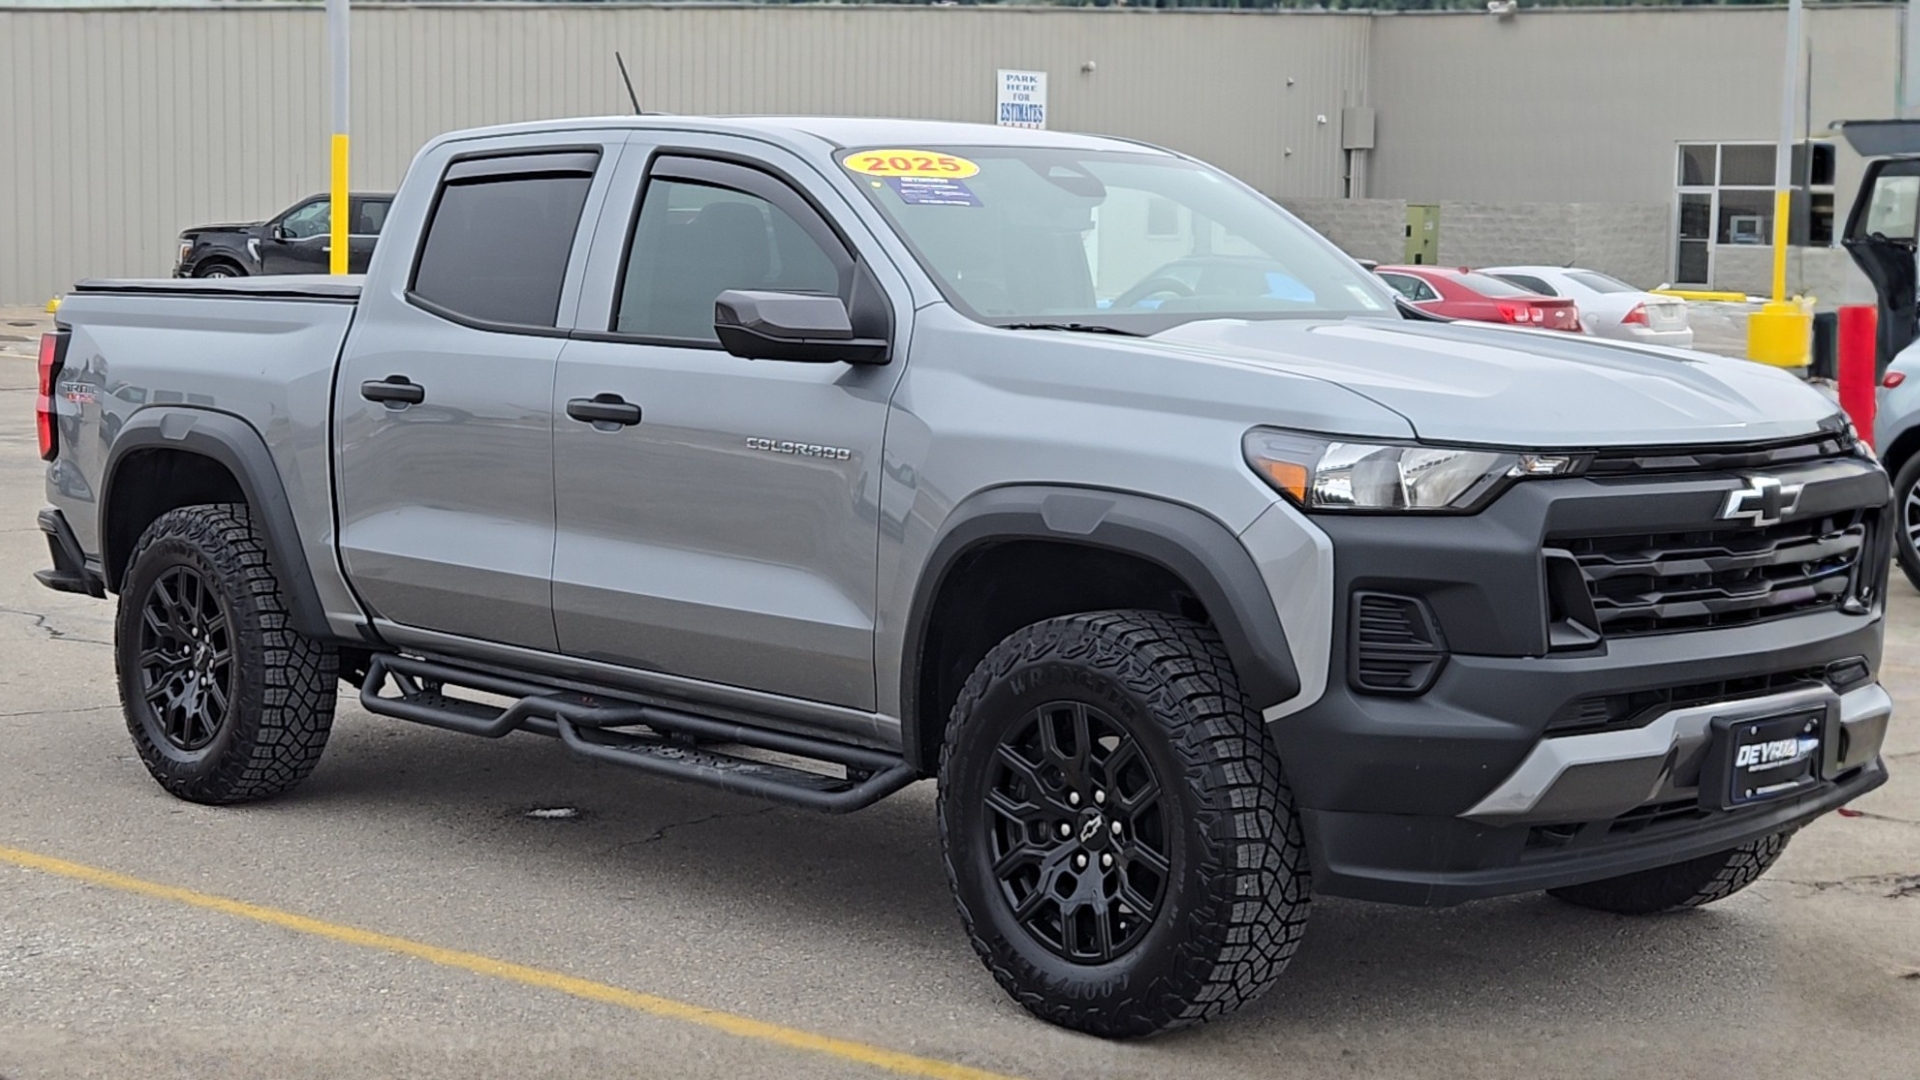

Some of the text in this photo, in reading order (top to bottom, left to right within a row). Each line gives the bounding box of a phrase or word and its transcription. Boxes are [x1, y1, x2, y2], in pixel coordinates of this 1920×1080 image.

[1006, 74, 1038, 83] PARK
[1006, 83, 1037, 92] HERE
[1012, 93, 1030, 102] FOR
[1000, 102, 1043, 123] ESTIMATES
[862, 157, 961, 172] 2025
[746, 437, 851, 460] COLORADO
